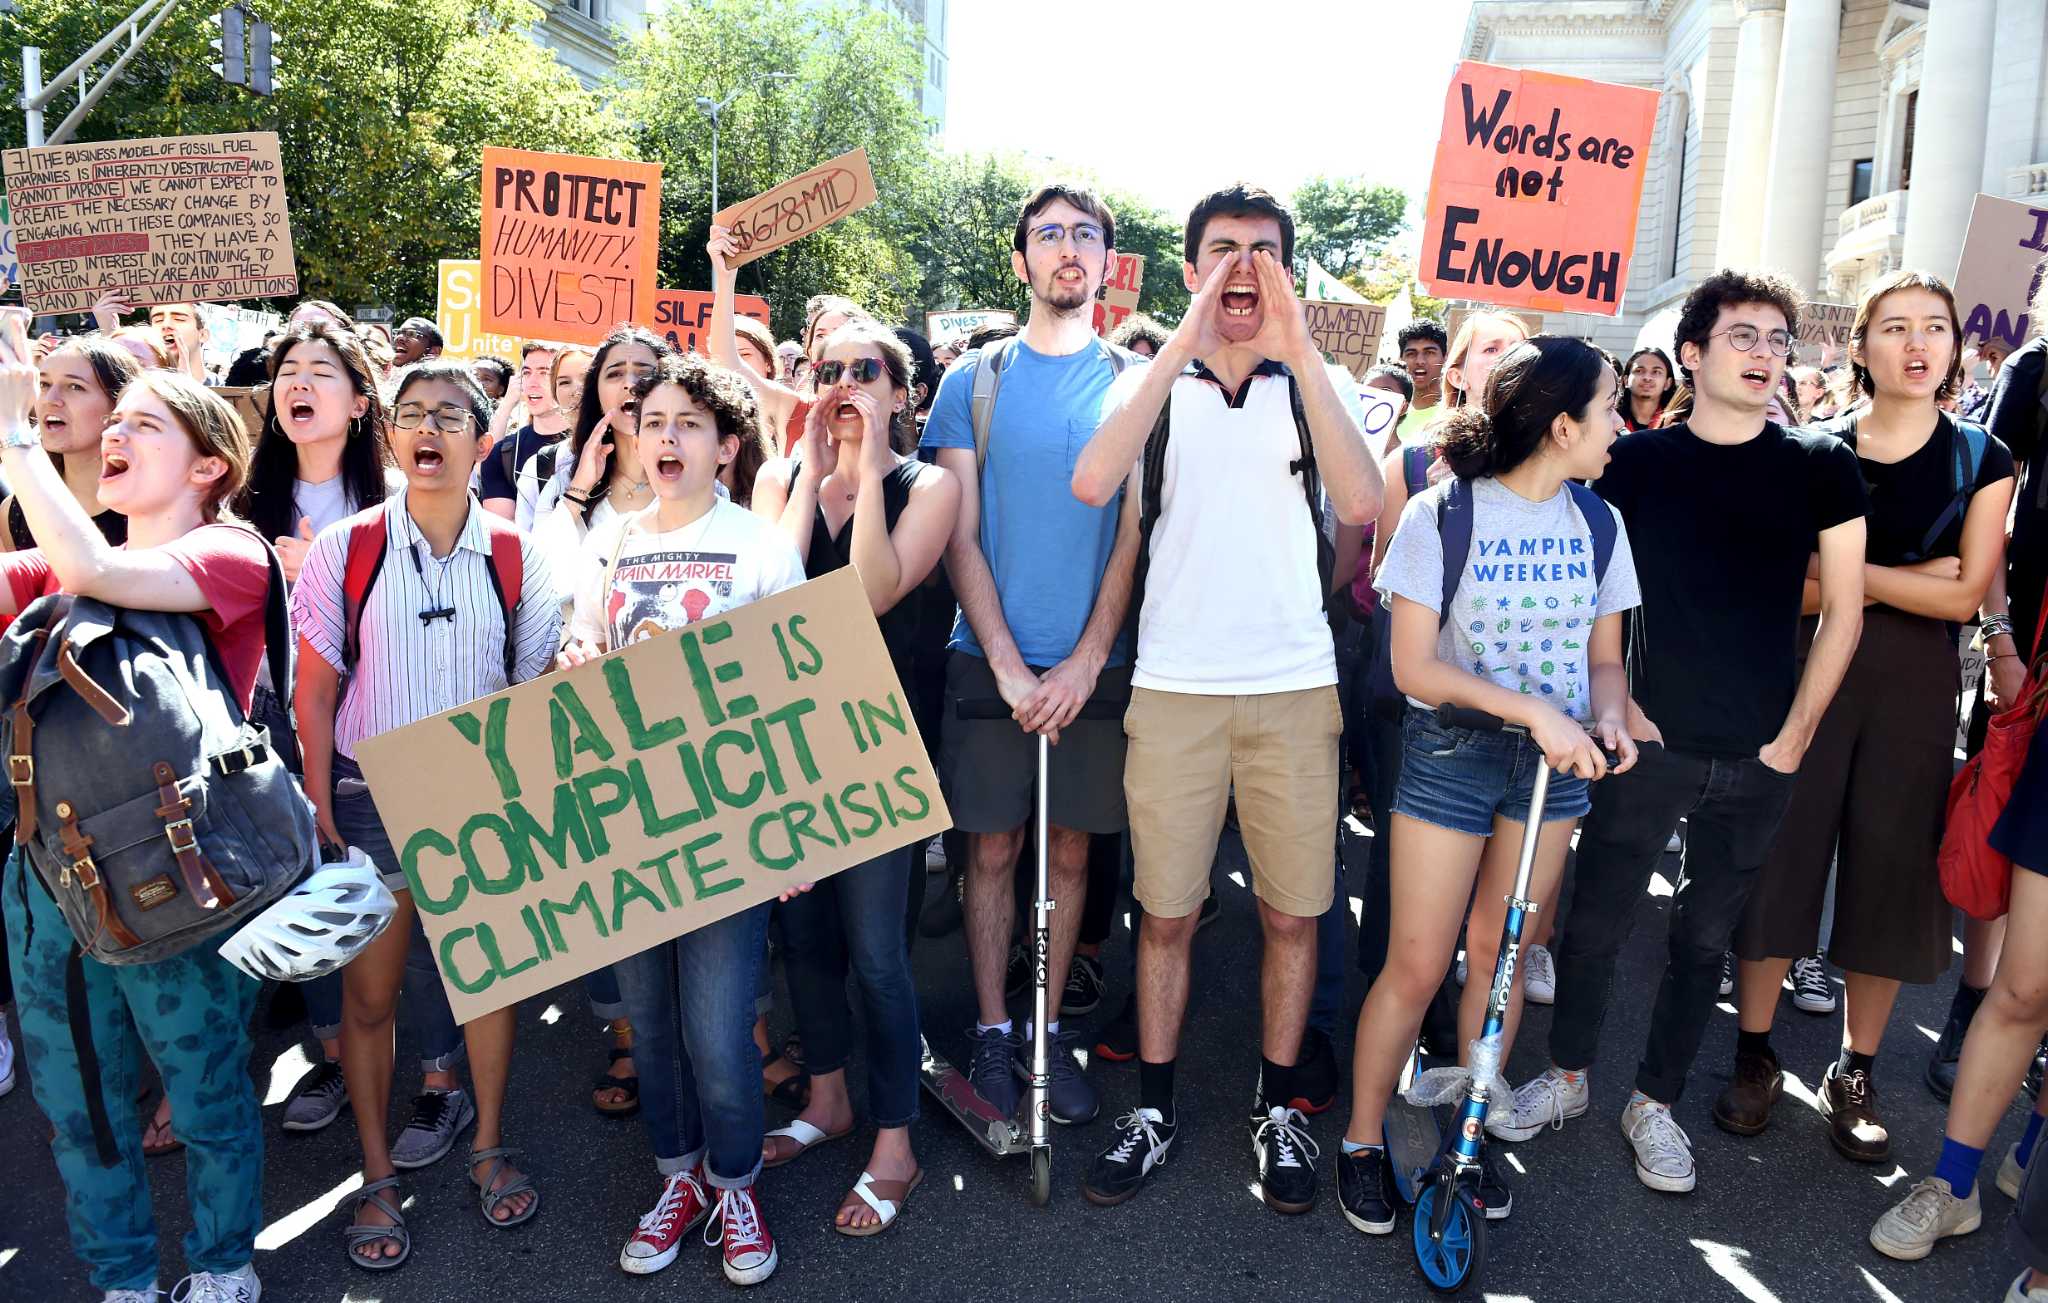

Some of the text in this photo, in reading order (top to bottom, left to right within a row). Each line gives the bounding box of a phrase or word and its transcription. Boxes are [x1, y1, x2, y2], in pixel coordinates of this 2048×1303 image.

[1461, 83, 1634, 169] Words are
[32, 151, 63, 170] THE
[65, 147, 117, 166] BUSINESS
[119, 145, 160, 159] MODEL
[160, 143, 176, 155] OF
[180, 142, 220, 156] FOSSIL
[223, 139, 258, 154] FUEL
[7, 160, 274, 189] COMPANIES IS INHERENTLY DESTRUCTIVE AND
[1496, 166, 1564, 202] not
[11, 176, 278, 207] CANNOT IMPROVE WE CANNOT EXPECT TO
[495, 167, 647, 229] PROTECT
[13, 205, 69, 226] CREATE
[72, 200, 102, 216] THE
[107, 196, 178, 214] NECESSARY
[184, 194, 239, 210] CHANGE
[250, 193, 271, 209] BY
[16, 212, 281, 242] ENGAGING WITH THESE COMPANIES, SO
[156, 232, 206, 250] THEY
[215, 229, 259, 248] HAVE
[264, 229, 279, 242] A
[493, 214, 636, 270] HUMANITY.
[21, 259, 78, 278] VESTED
[85, 252, 147, 271] INTEREST
[152, 252, 166, 267] IN
[171, 249, 251, 266] CONTINUING
[256, 247, 274, 262] TO
[1436, 205, 1620, 303] ENOUGH
[24, 263, 269, 294] FUNCTION AS THEY ARE AND THEY
[26, 291, 78, 313] STAND
[149, 284, 184, 303] WAY
[192, 283, 213, 298] OF
[217, 277, 296, 298] SOLUTIONS
[493, 264, 634, 327] DIVEST!
[940, 315, 988, 330] DIVEST
[1305, 304, 1385, 335] DOWMENT
[1309, 330, 1378, 357] STICE
[626, 552, 700, 566] THE MIGHTY
[658, 562, 733, 580] MARVEL
[1473, 560, 1595, 582] WEEKEN
[448, 615, 824, 800] YALE IS
[400, 692, 907, 916] COMPLICIT IN
[439, 766, 930, 995] CLIMATE CRISIS
